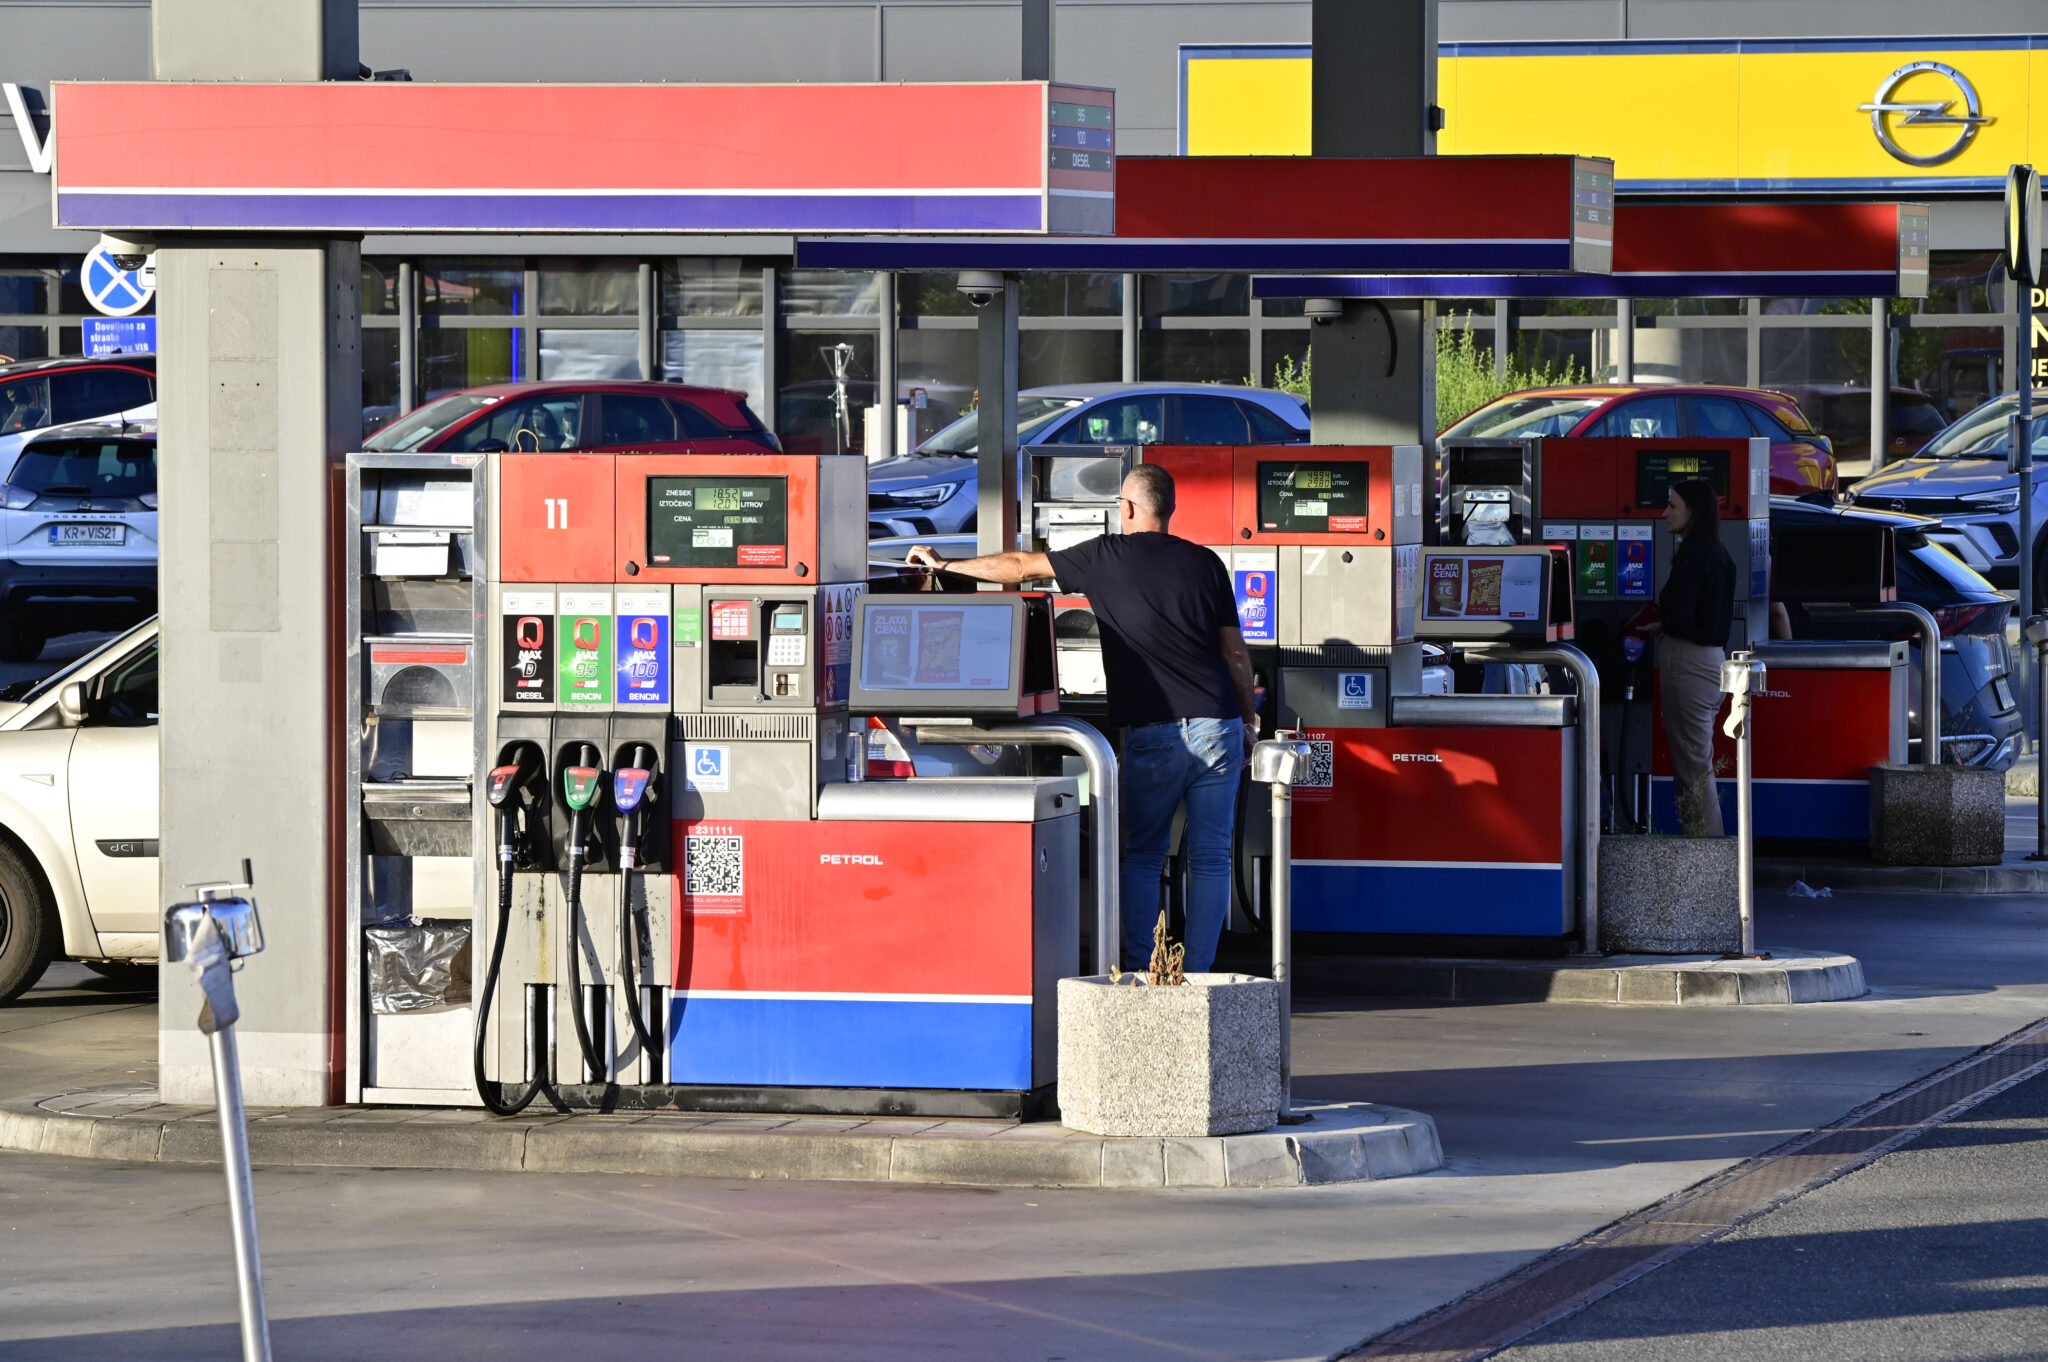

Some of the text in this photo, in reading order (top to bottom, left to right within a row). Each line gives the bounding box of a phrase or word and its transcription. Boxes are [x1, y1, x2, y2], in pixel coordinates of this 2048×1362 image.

[1077, 108, 1086, 122] 95
[1077, 130, 1087, 145] 100
[1072, 153, 1090, 168] DIESEL
[136, 322, 146, 331] za
[134, 343, 149, 352] VIS
[659, 499, 692, 507] IZTOČENO
[544, 498, 568, 529] 11
[64, 527, 116, 539] KR VIS21
[1303, 549, 1327, 575] 7
[1433, 570, 1459, 578] CENA!
[1245, 572, 1267, 598] Q
[1245, 607, 1267, 619] 100
[875, 616, 907, 625] ZLATA
[516, 616, 544, 650] Q
[573, 617, 600, 650] Q
[631, 617, 658, 650] Q
[874, 625, 907, 635] CENA!
[518, 650, 542, 660] MAX
[575, 651, 599, 660] MAX
[633, 651, 656, 660] MAX
[523, 662, 537, 677] D
[574, 662, 598, 677] 95
[630, 662, 658, 677] 100
[516, 691, 544, 700] DIESEL
[571, 692, 601, 701] BENCIN
[629, 692, 660, 701] BENCIN
[1392, 753, 1443, 763] PETROL
[695, 826, 733, 835] 231111
[820, 854, 884, 865] PETROL
